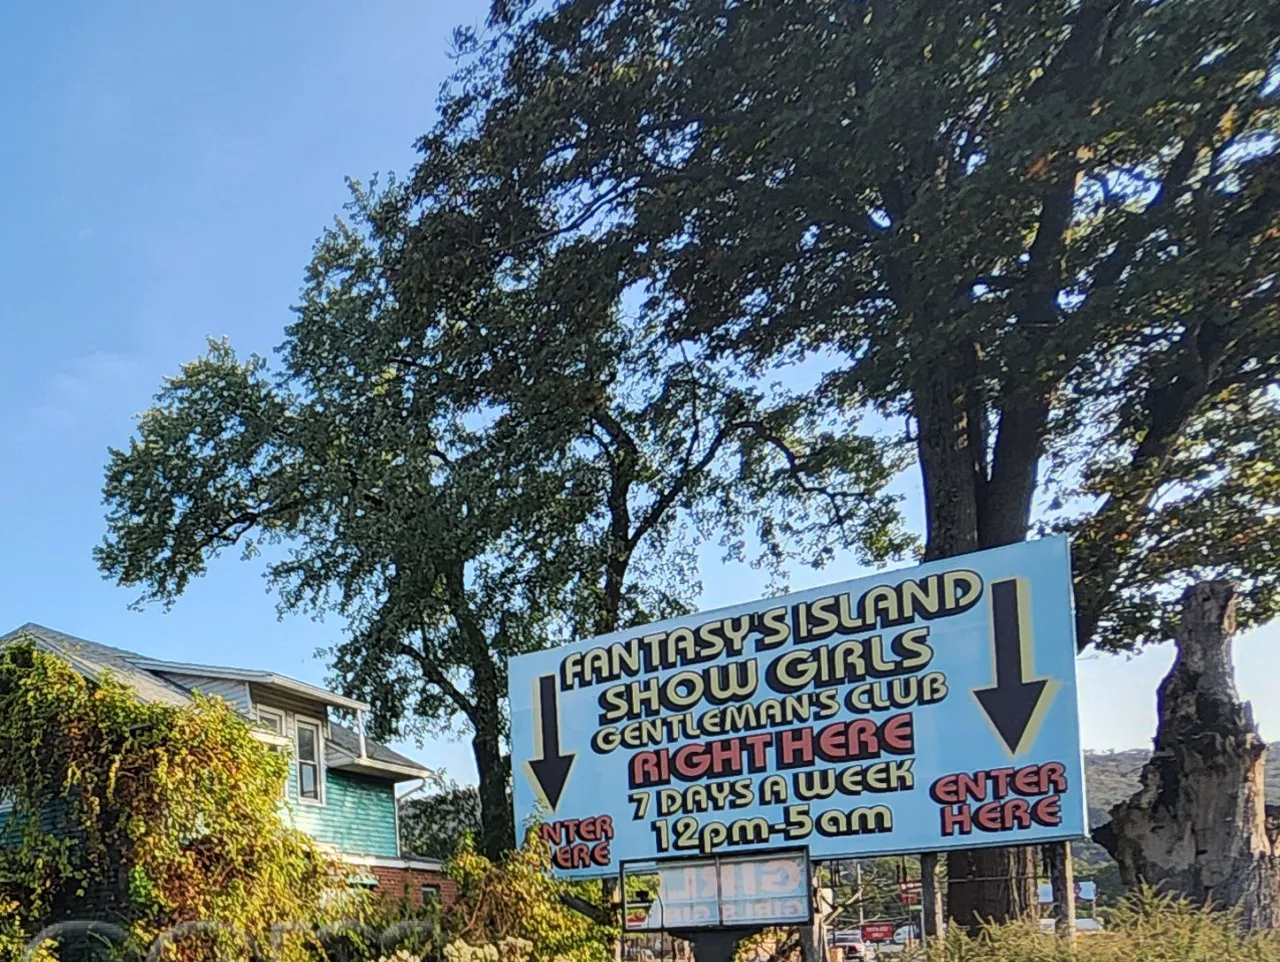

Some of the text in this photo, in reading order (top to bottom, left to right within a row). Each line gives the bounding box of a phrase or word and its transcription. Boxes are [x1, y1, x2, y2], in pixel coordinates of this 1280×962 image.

[560, 568, 984, 692] FANTASY'S ISLAND
[598, 625, 934, 726] SHOW GIRLS
[591, 671, 949, 755] GENTLEMAN'S CLUB
[629, 712, 916, 790] RIGHT HERE
[929, 761, 1068, 805] ENTER
[629, 757, 916, 821] 7 DAYS A WEEK
[940, 794, 1062, 837] HERE
[535, 814, 615, 846] NTER
[544, 841, 611, 870] ERE
